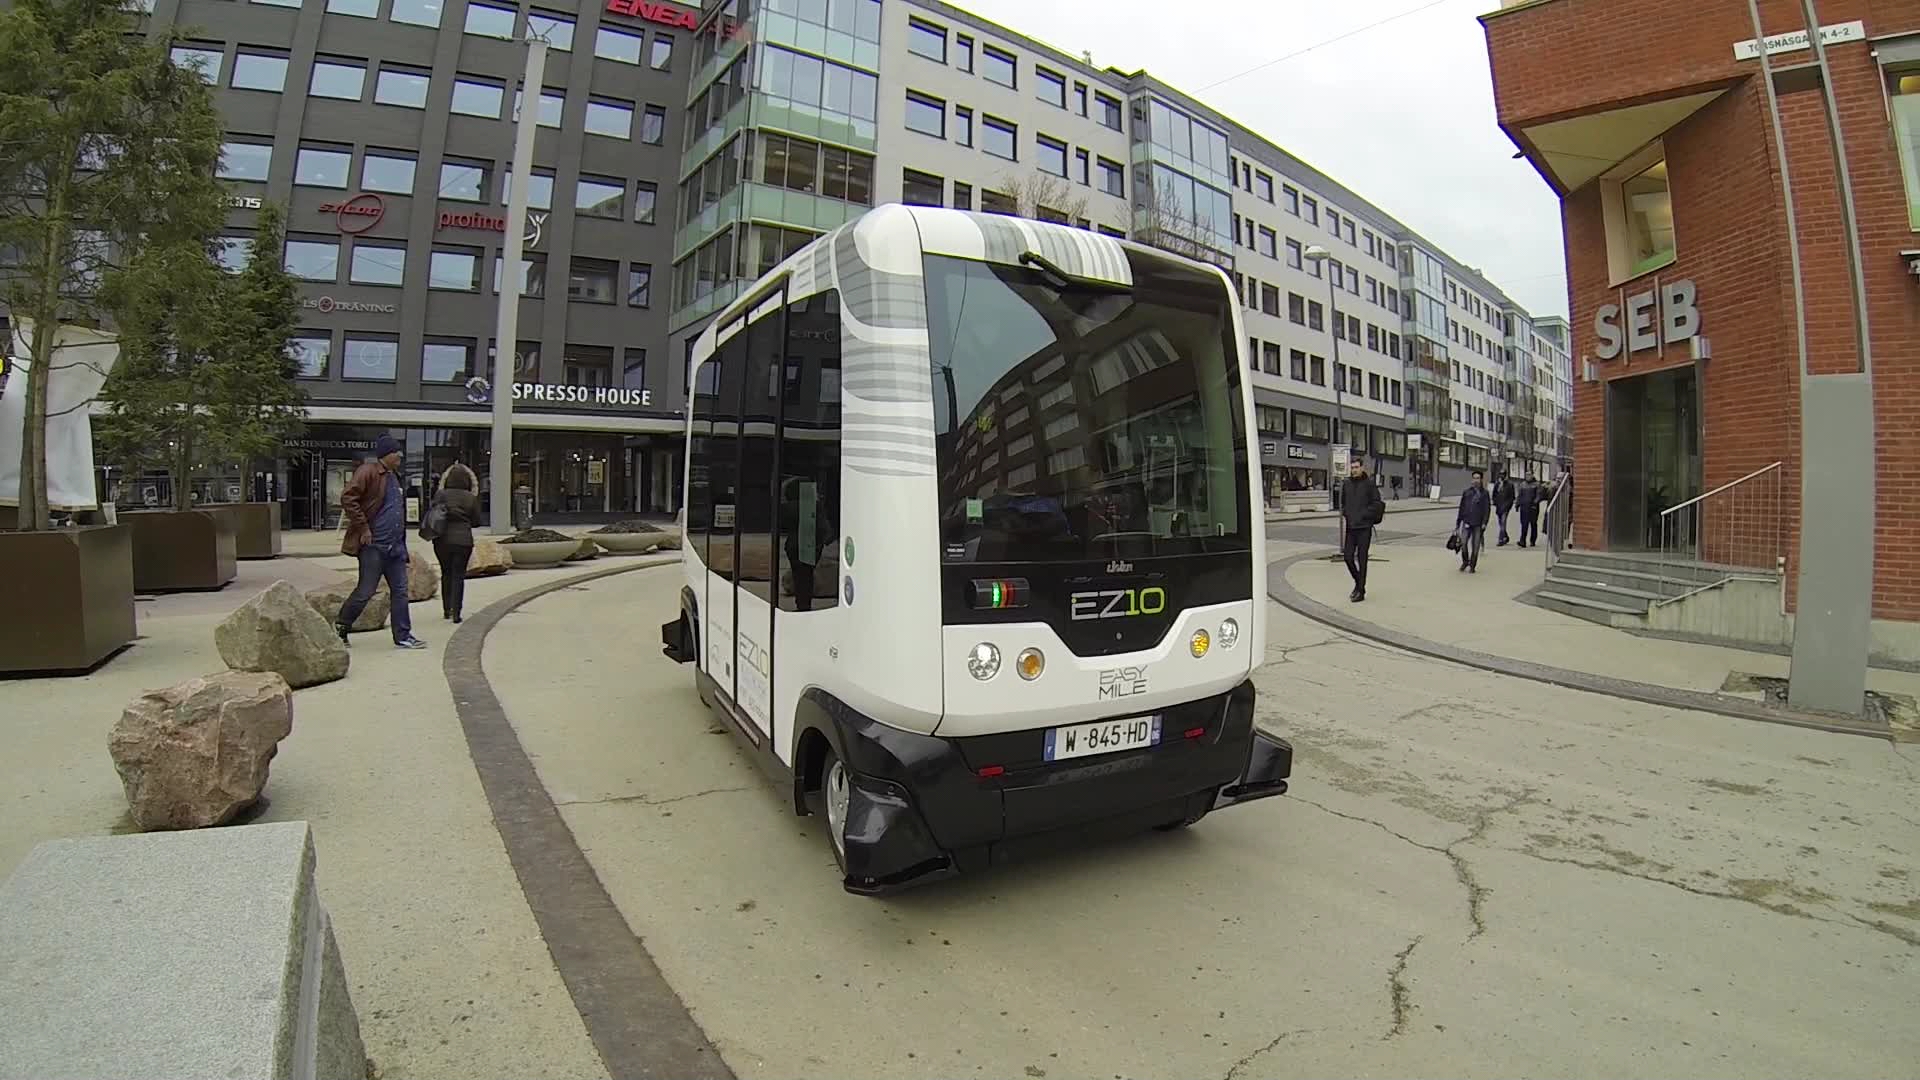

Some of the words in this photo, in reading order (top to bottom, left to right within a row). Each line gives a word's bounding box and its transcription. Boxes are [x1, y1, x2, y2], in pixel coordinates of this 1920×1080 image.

[606, 0, 698, 30] ENEA
[1831, 27, 1850, 38] 4-2
[1594, 279, 1701, 360] SEB
[511, 382, 588, 402] SPRESSO
[595, 386, 651, 406] HOUSE
[347, 441, 368, 449] TORG
[1071, 586, 1165, 620] EZ10
[1099, 664, 1148, 685] EASY
[1099, 679, 1147, 701] MILE
